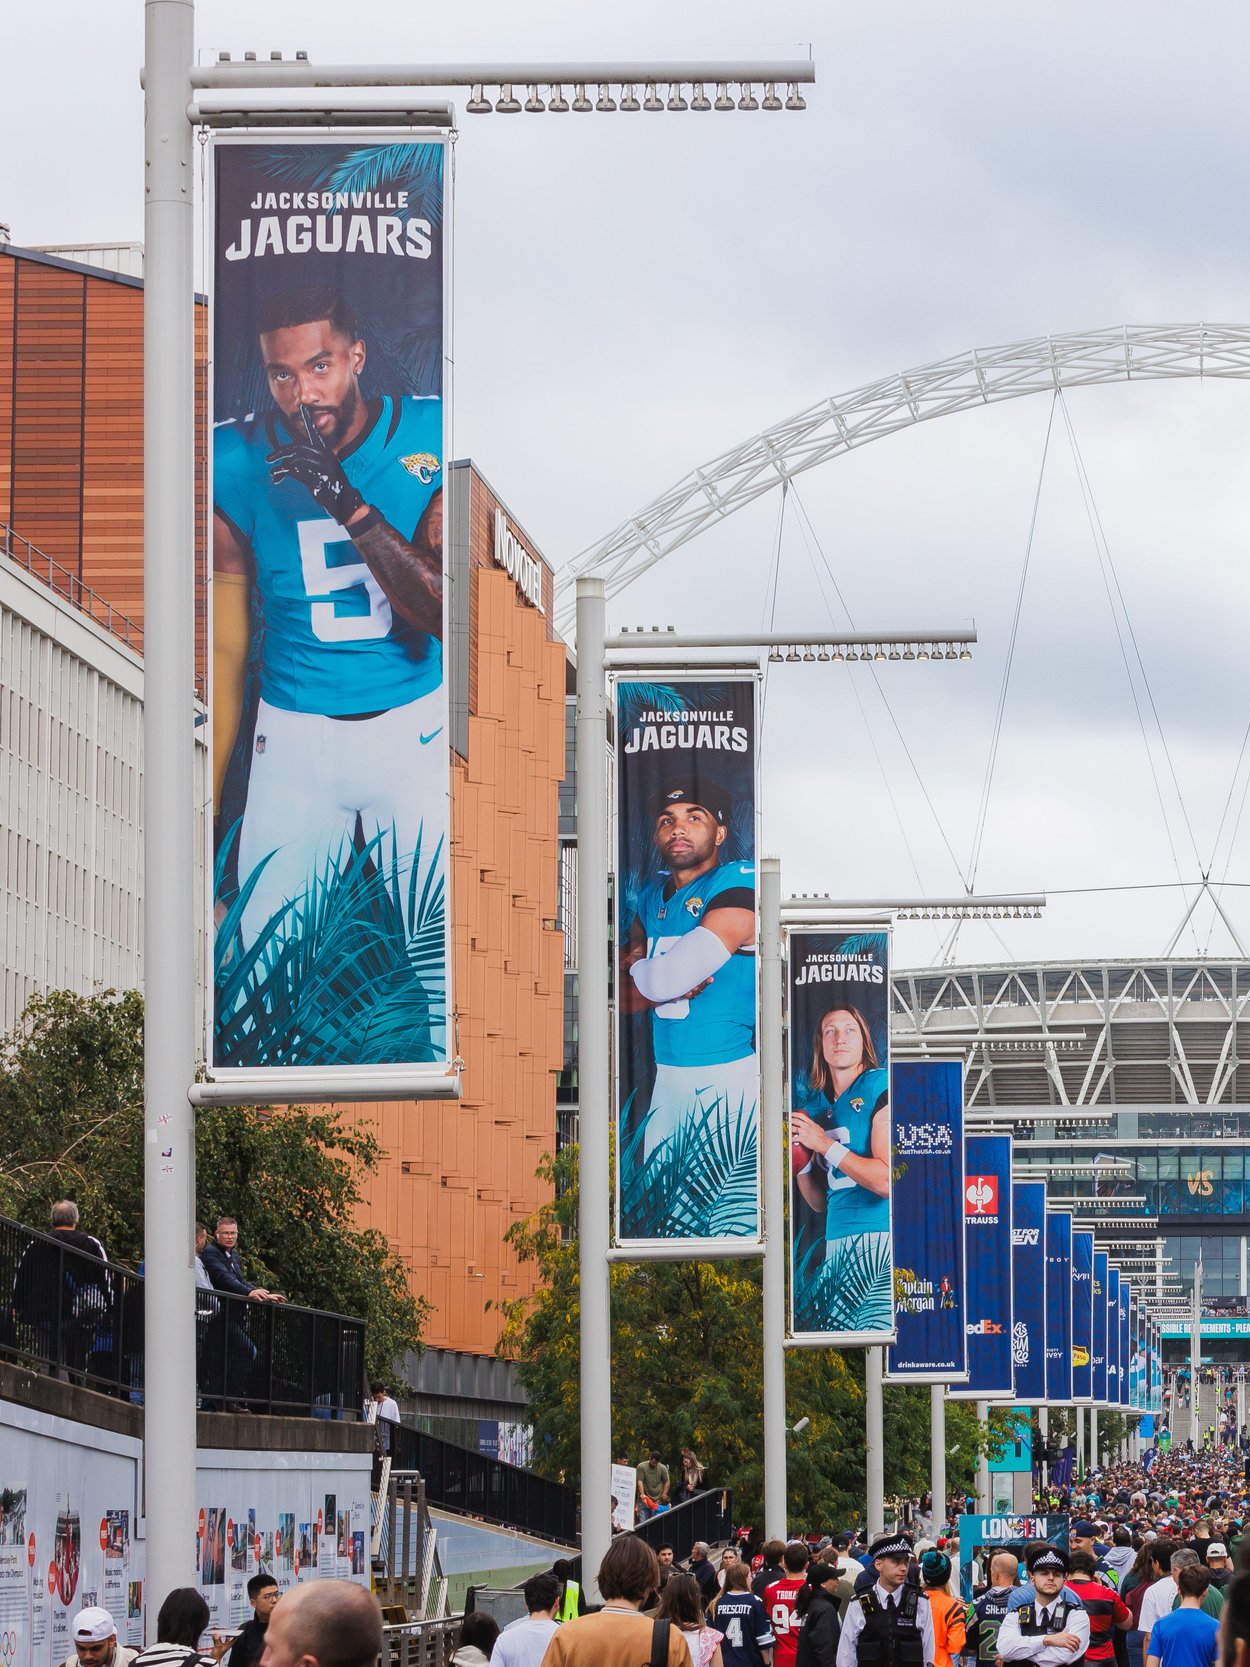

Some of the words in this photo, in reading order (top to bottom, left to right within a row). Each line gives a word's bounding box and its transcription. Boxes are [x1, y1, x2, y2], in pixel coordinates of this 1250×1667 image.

[251, 192, 409, 209] JACKSONVILLE
[225, 214, 432, 262] JAGUARS
[494, 507, 546, 616] NOVOTEL
[639, 710, 734, 722] JACKSONVILLE
[624, 724, 748, 754] JAGUARS
[805, 953, 873, 963] JACKSONVILLE
[795, 963, 884, 986] JAGUARS
[897, 1123, 952, 1148] USA
[1187, 1170, 1214, 1196] VS
[1022, 1228, 1040, 1236] FOR
[966, 1319, 1002, 1335] edEx
[717, 1604, 752, 1615] PRESCOTT
[725, 1617, 744, 1648] 4
